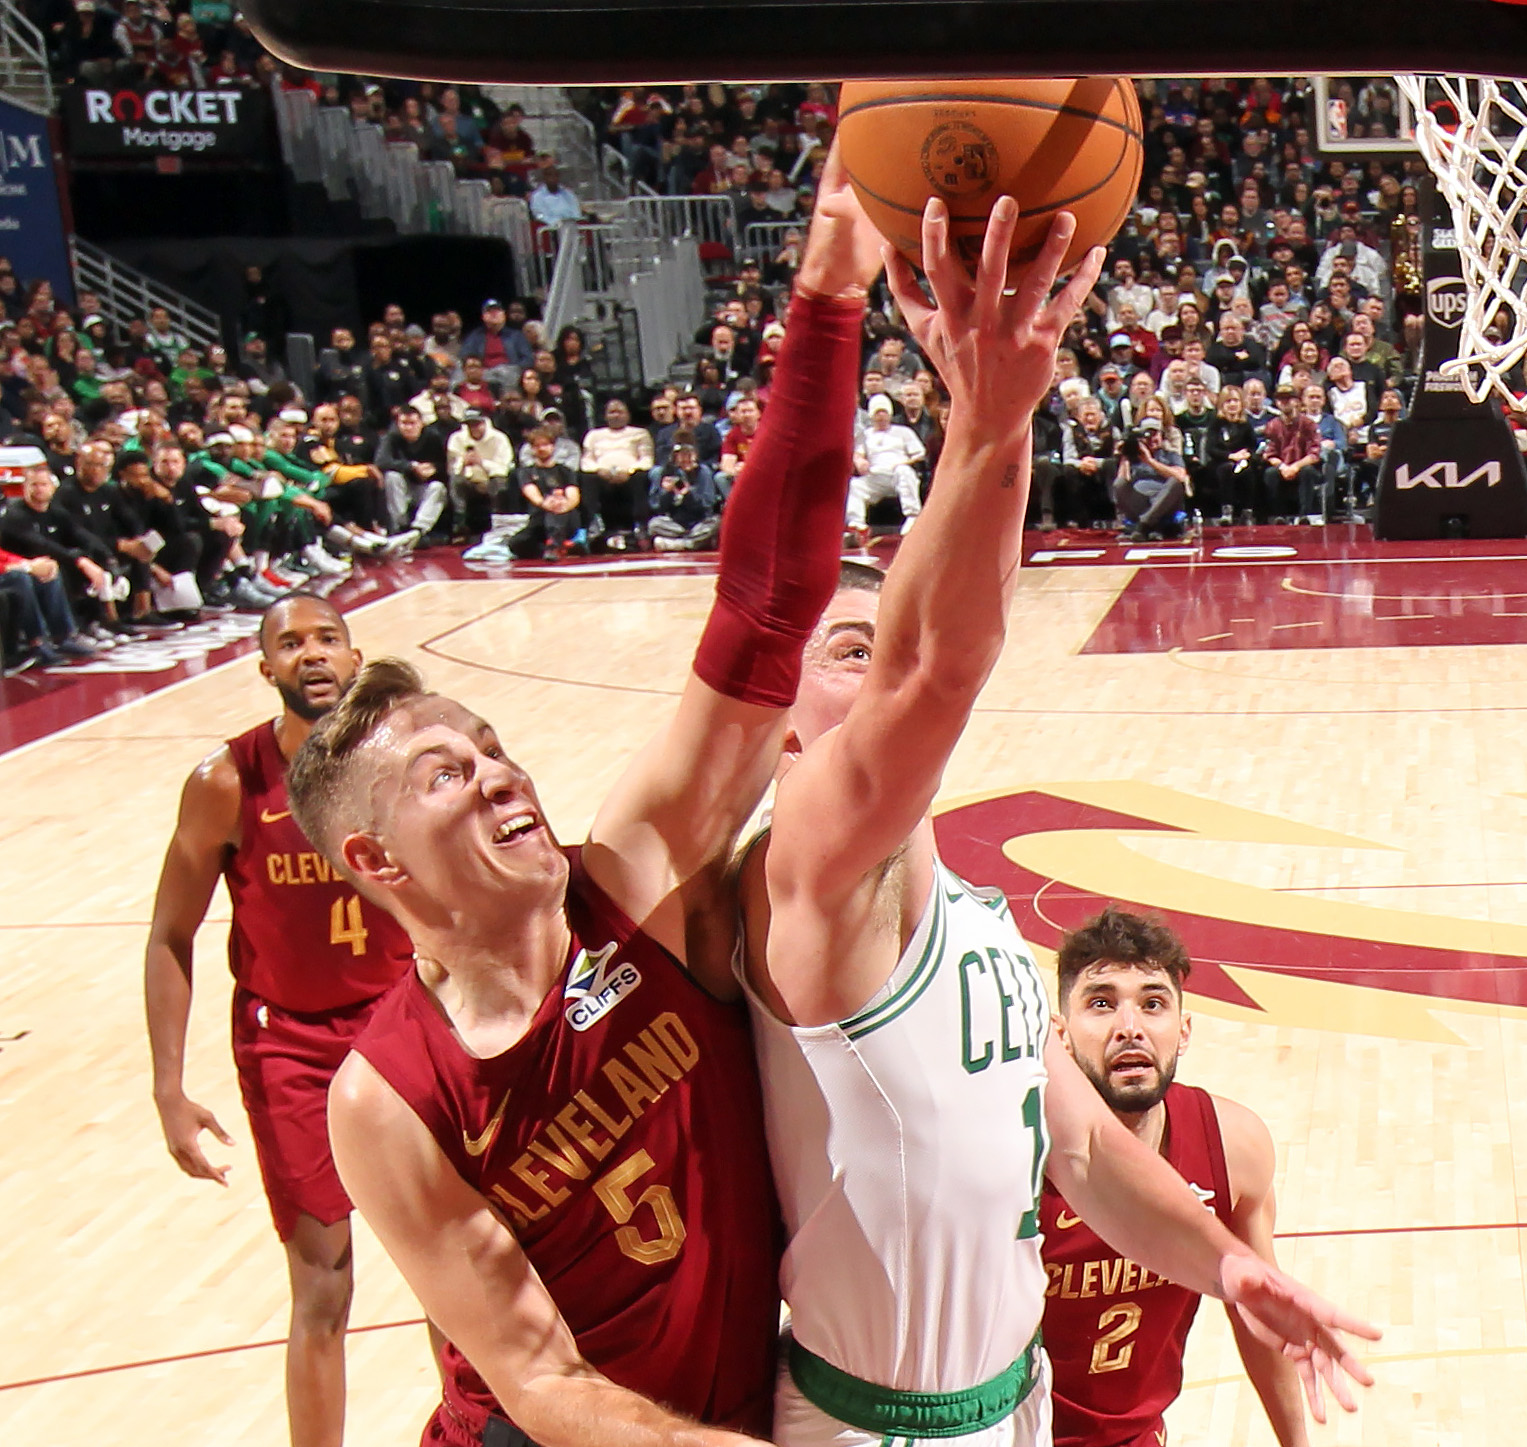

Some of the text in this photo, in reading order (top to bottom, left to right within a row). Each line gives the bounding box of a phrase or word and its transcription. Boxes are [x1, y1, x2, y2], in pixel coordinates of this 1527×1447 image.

[85, 90, 242, 124] ROCKET
[122, 127, 217, 151] Mortgage
[1432, 293, 1466, 320] ups
[330, 894, 369, 956] 4
[571, 967, 638, 1026] CLIFFS
[592, 1148, 687, 1265] 5
[1088, 1302, 1143, 1374] 2
